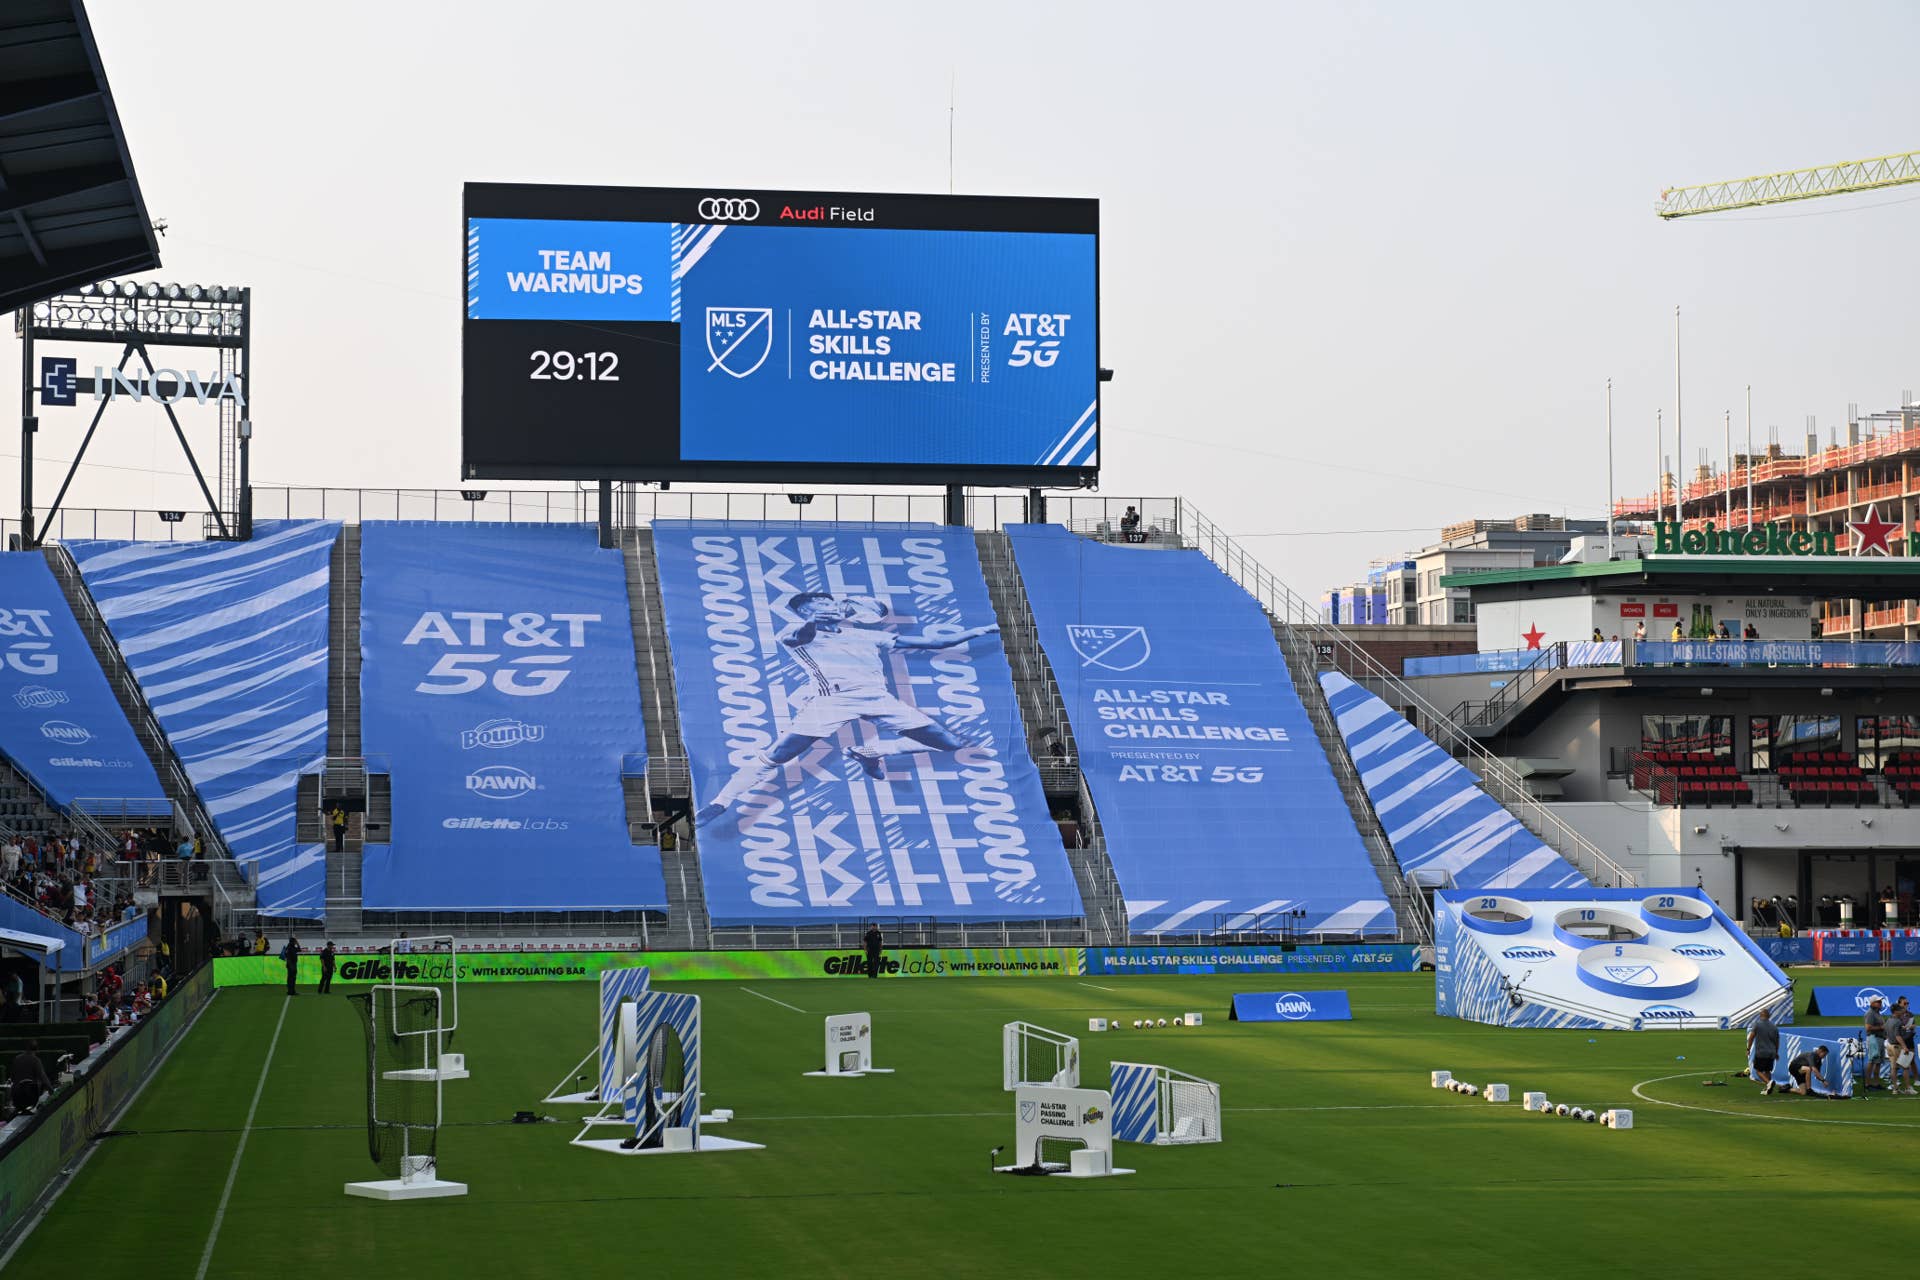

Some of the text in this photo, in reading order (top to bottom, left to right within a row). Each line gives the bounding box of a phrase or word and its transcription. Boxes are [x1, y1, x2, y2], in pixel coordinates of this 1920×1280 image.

[780, 207, 875, 221] Audi Field
[538, 250, 611, 271] TEAM
[507, 271, 643, 295] WARMUPS
[711, 313, 746, 328] MLS
[809, 309, 921, 331] ALL-STAR
[1003, 314, 1071, 336] AT&T
[809, 335, 891, 356] SKILLS
[981, 312, 991, 383] PRESENTED BY
[1008, 341, 1060, 367] 5G
[529, 350, 620, 382] 29:12
[809, 361, 956, 382] CHALLENGE
[93, 365, 246, 407] INOVA
[164, 512, 180, 521] 134
[1129, 534, 1143, 542] 137
[1654, 521, 1838, 557] Heineken
[1745, 608, 1808, 619] ONLY 3 INGREDIENTS
[402, 612, 601, 648] AT&T
[1074, 628, 1116, 639] MLS
[0, 642, 59, 675] G
[1695, 646, 1747, 660] ALL-STARS
[1762, 646, 1807, 660] ARSENAL
[1809, 646, 1821, 660] FC
[415, 653, 572, 696] 5G
[1093, 689, 1230, 706] ALL-STAR
[1098, 706, 1199, 722] SKILLS
[40, 726, 91, 739] DAWN
[461, 724, 544, 749] Bounty
[1104, 724, 1289, 742] CHALLENGE
[1111, 752, 1180, 760] PRESENTED
[1118, 765, 1264, 783] AT&T 5G
[466, 775, 536, 790] DAWN
[1481, 898, 1497, 909] 20
[1658, 897, 1675, 908] 20
[1580, 910, 1596, 921] 10
[1501, 950, 1557, 960] DAWN
[1614, 946, 1623, 957] 5
[1671, 948, 1726, 957] DAWN
[951, 963, 975, 971] WITH
[977, 962, 1038, 971] EXFOLIATING
[1040, 962, 1059, 970] BAR
[1104, 954, 1393, 966] MLS ALL-STAR SKILLS CHALLENGE PRESENTED BY AT&T 5G
[472, 968, 498, 976] WITH
[500, 966, 564, 976] EXFOLIATING
[566, 967, 585, 975] BAR
[1609, 966, 1636, 974] MLS
[1276, 1002, 1312, 1013] DAWN
[1855, 996, 1890, 1008] DAN
[1633, 1018, 1643, 1031] 2
[1720, 1017, 1730, 1030] 2
[1041, 1102, 1067, 1110] ALL-STAR
[1041, 1119, 1074, 1127] CHALLENGE
